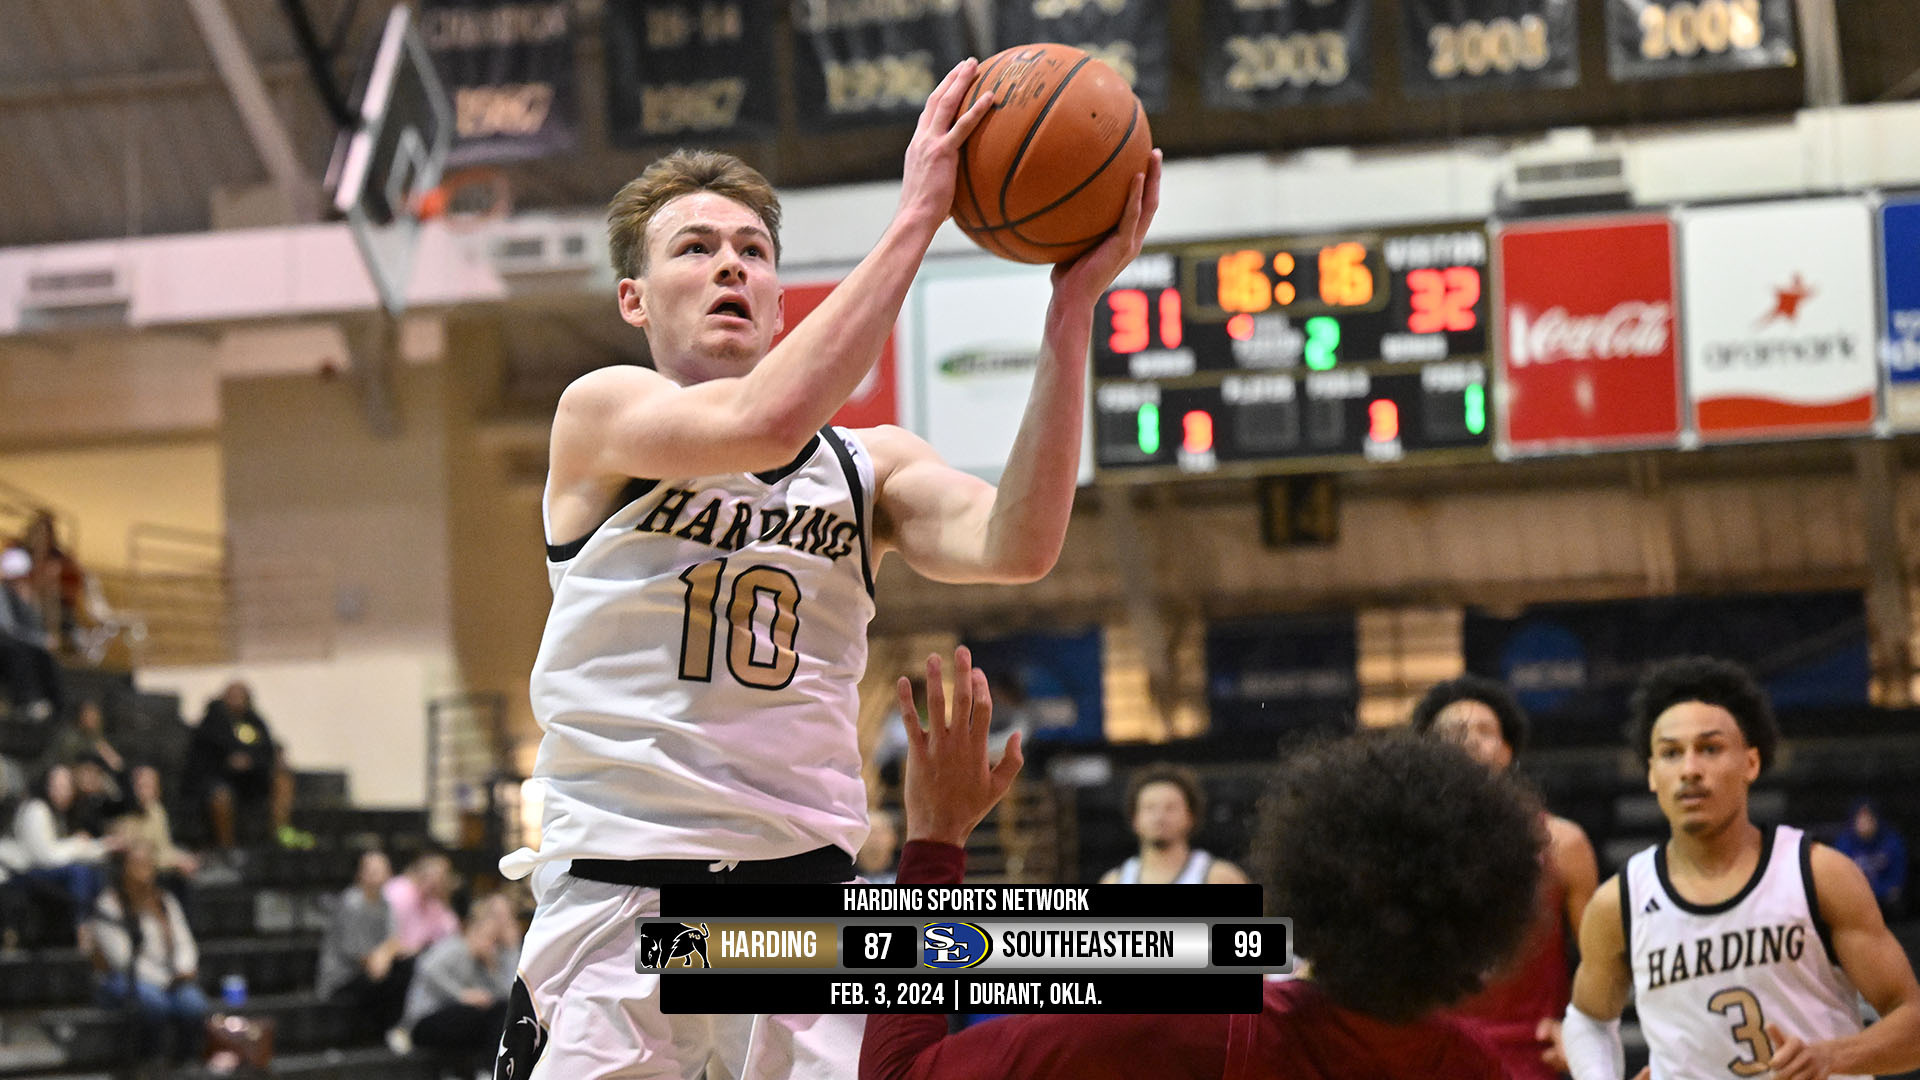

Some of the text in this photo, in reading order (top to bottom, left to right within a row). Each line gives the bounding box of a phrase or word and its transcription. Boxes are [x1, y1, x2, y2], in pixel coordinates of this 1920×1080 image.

[1223, 29, 1351, 91] 2003
[1108, 287, 1182, 354] 31
[1406, 266, 1480, 334] 32
[1304, 316, 1341, 371] 2
[635, 488, 859, 562] HARDING
[678, 557, 802, 691] 10
[1648, 924, 1805, 990] HARDING
[1707, 986, 1774, 1078] 3
